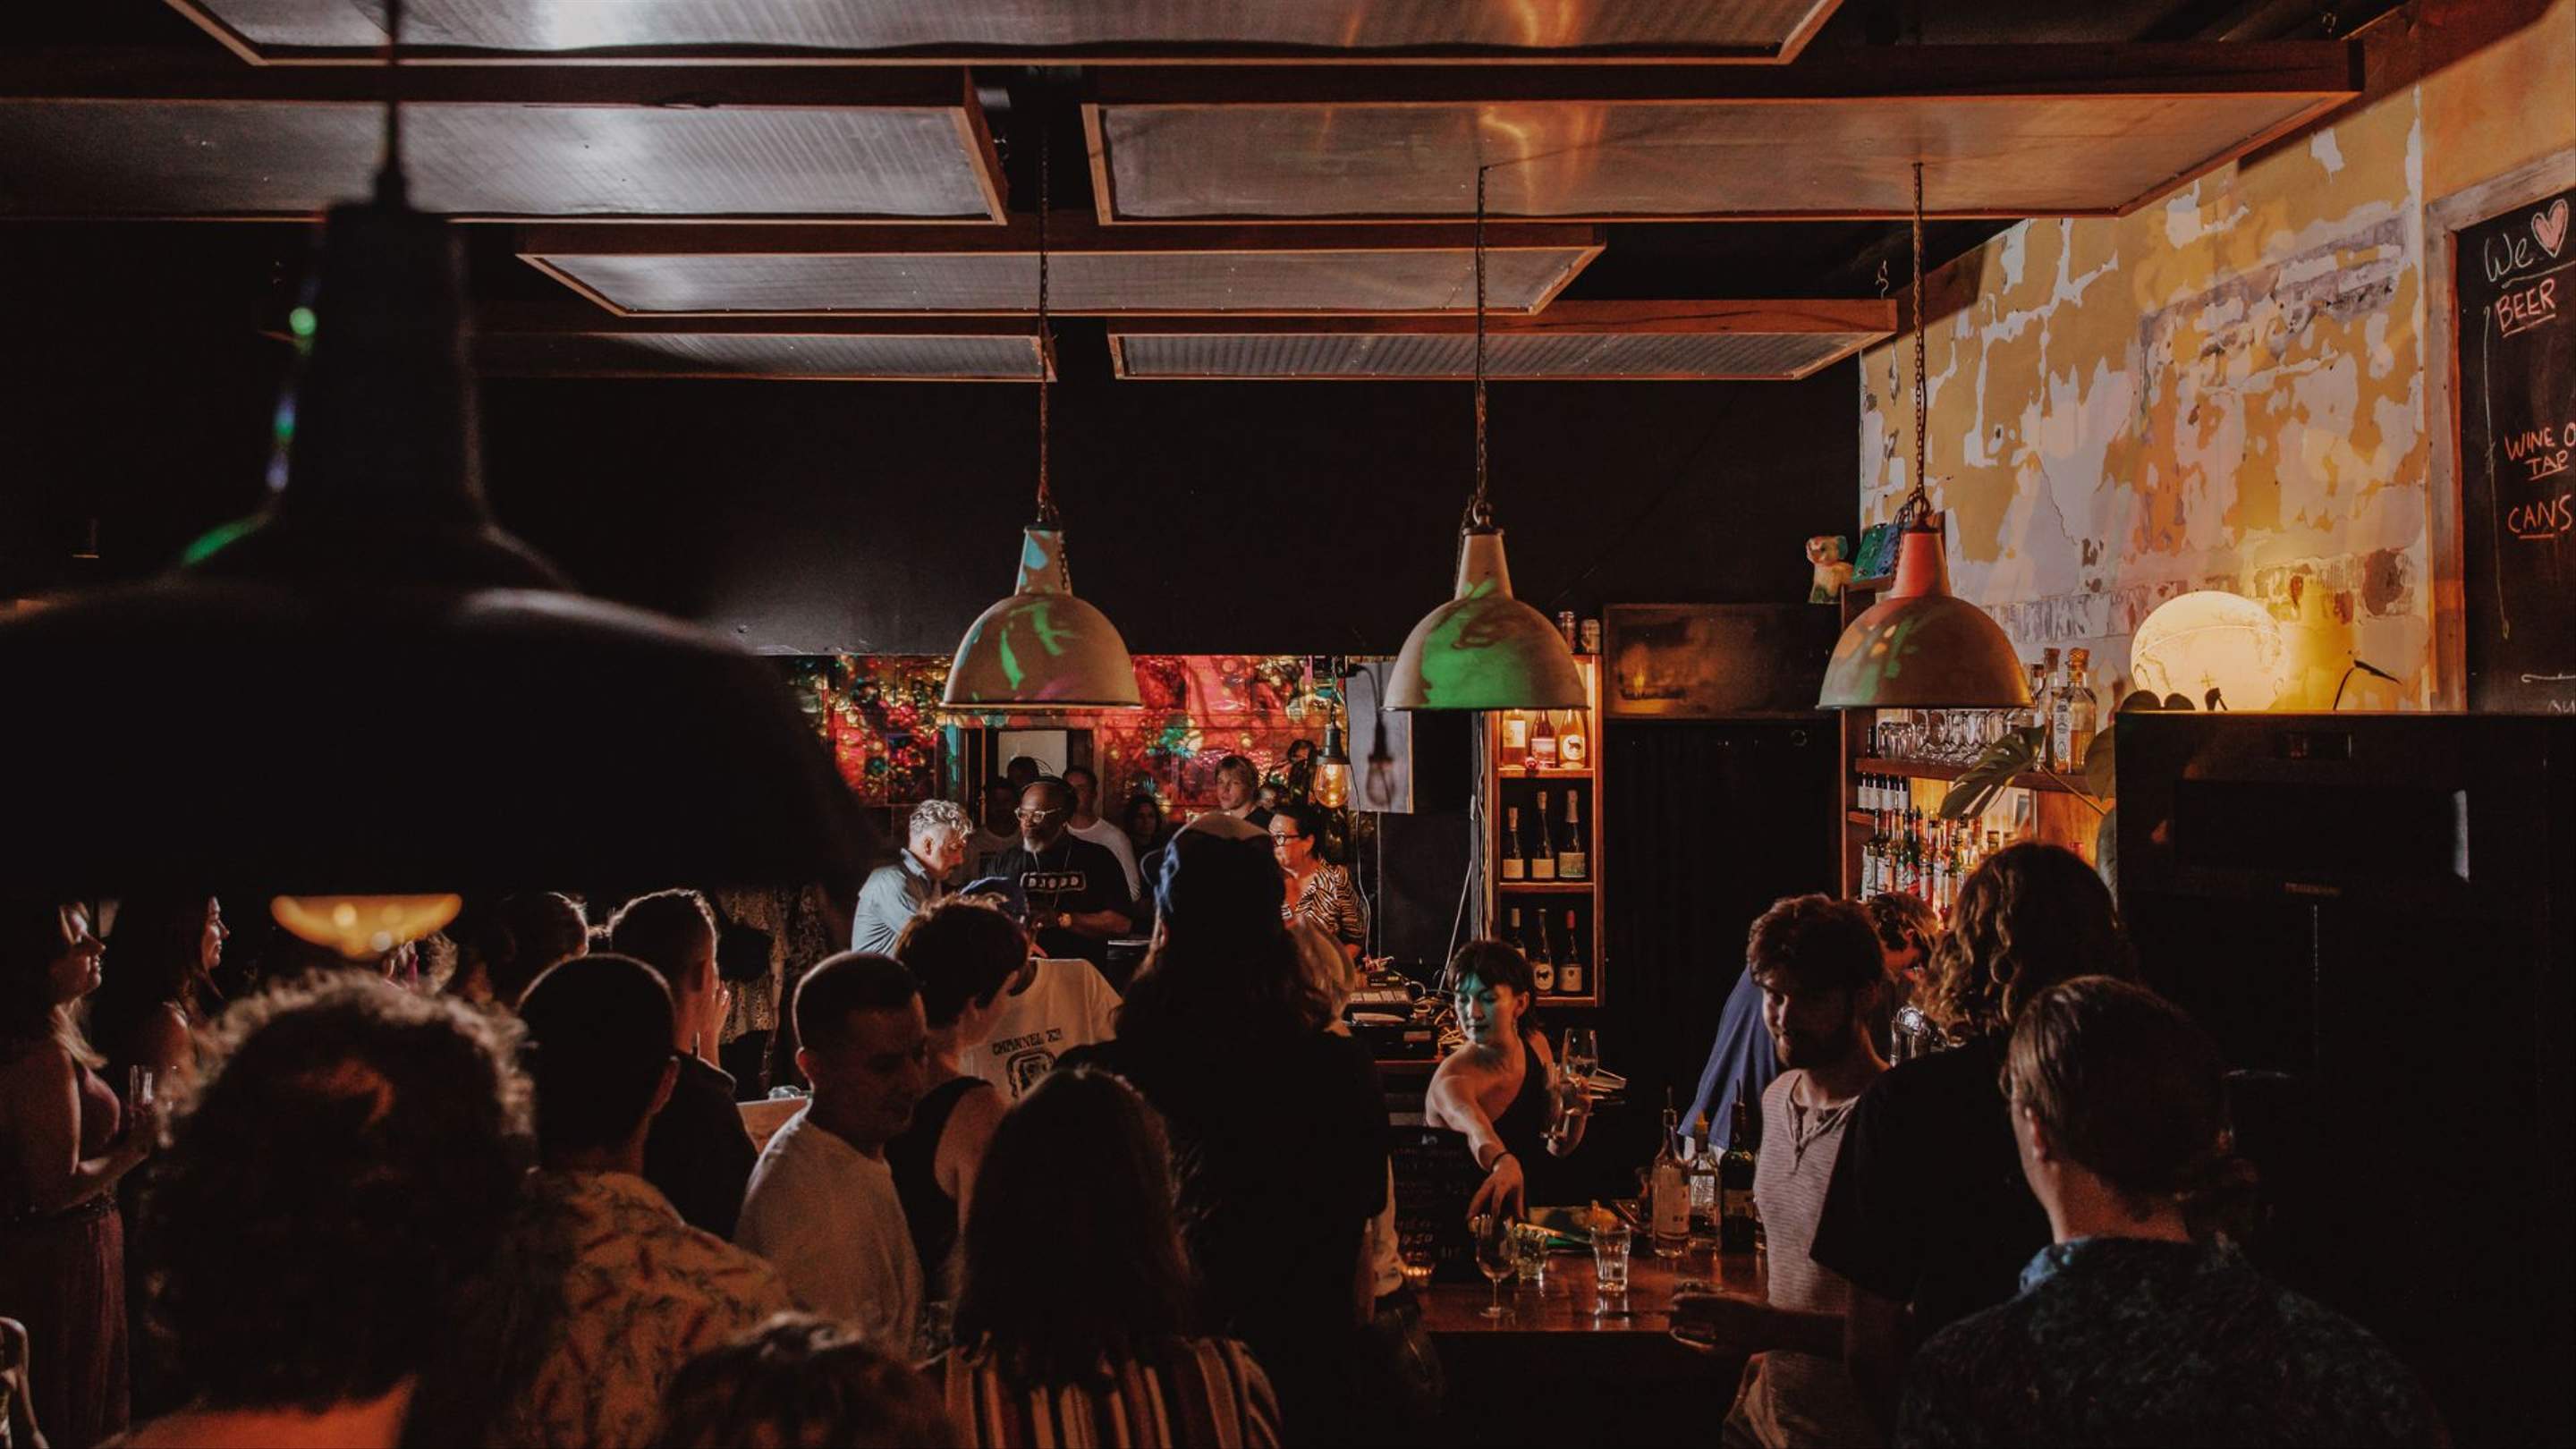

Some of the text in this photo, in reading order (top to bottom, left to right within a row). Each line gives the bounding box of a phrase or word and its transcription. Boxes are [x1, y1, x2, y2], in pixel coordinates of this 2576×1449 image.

[2484, 233, 2534, 283] We
[2496, 277, 2555, 332] BEER
[2504, 427, 2555, 462] WINE
[2524, 449, 2568, 476] TAP
[2507, 494, 2572, 533] CANS
[992, 1032, 1045, 1055] CHANNEL
